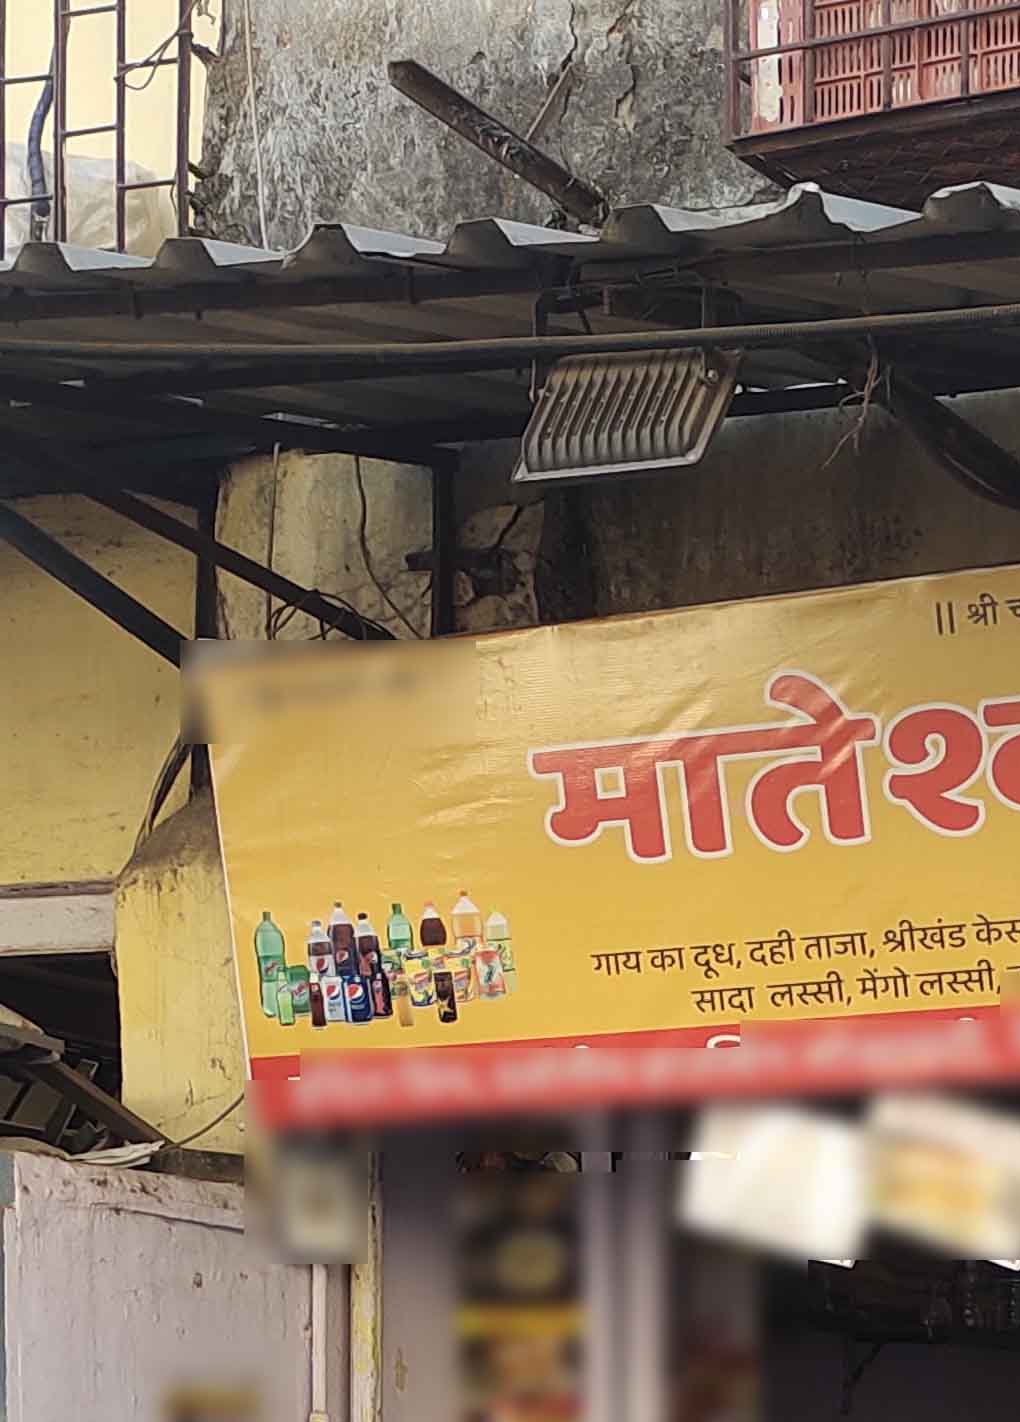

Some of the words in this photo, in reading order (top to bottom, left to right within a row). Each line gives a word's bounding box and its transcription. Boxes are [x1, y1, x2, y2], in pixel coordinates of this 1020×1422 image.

[967, 593, 999, 626] श्री
[591, 948, 644, 978] गाय
[648, 945, 685, 973] का
[689, 939, 743, 980] दूध,
[745, 930, 794, 969] दही
[803, 930, 876, 963] ताजा,
[882, 918, 967, 955] श्रीखंड
[690, 984, 755, 1015] सादा
[767, 969, 853, 1008] लस्सी,
[856, 966, 912, 1000] मेंगो
